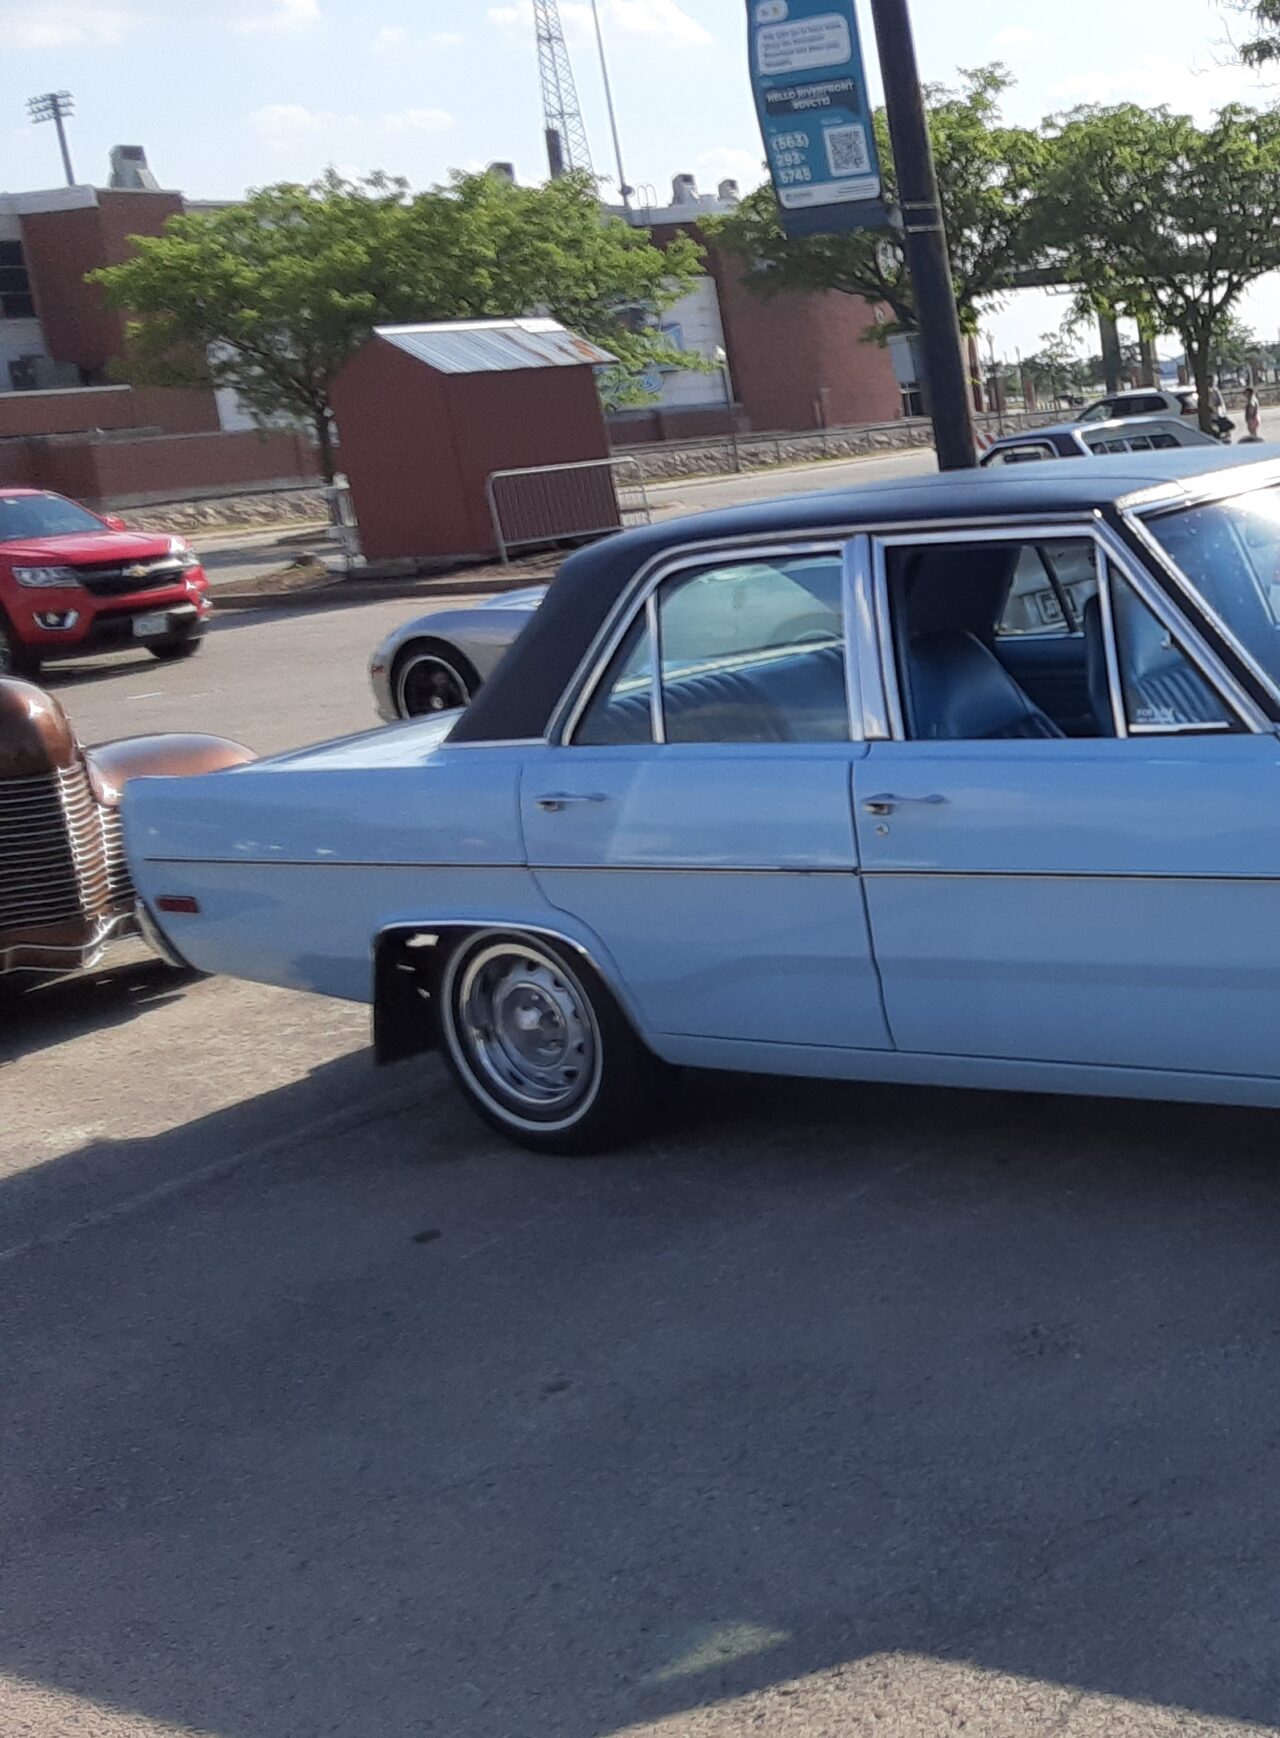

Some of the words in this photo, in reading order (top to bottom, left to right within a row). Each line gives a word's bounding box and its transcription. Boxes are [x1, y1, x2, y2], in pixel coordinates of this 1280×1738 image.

[767, 91, 797, 102] HELLO
[797, 82, 854, 98] RIVERFRONT
[780, 167, 811, 184] 5745
